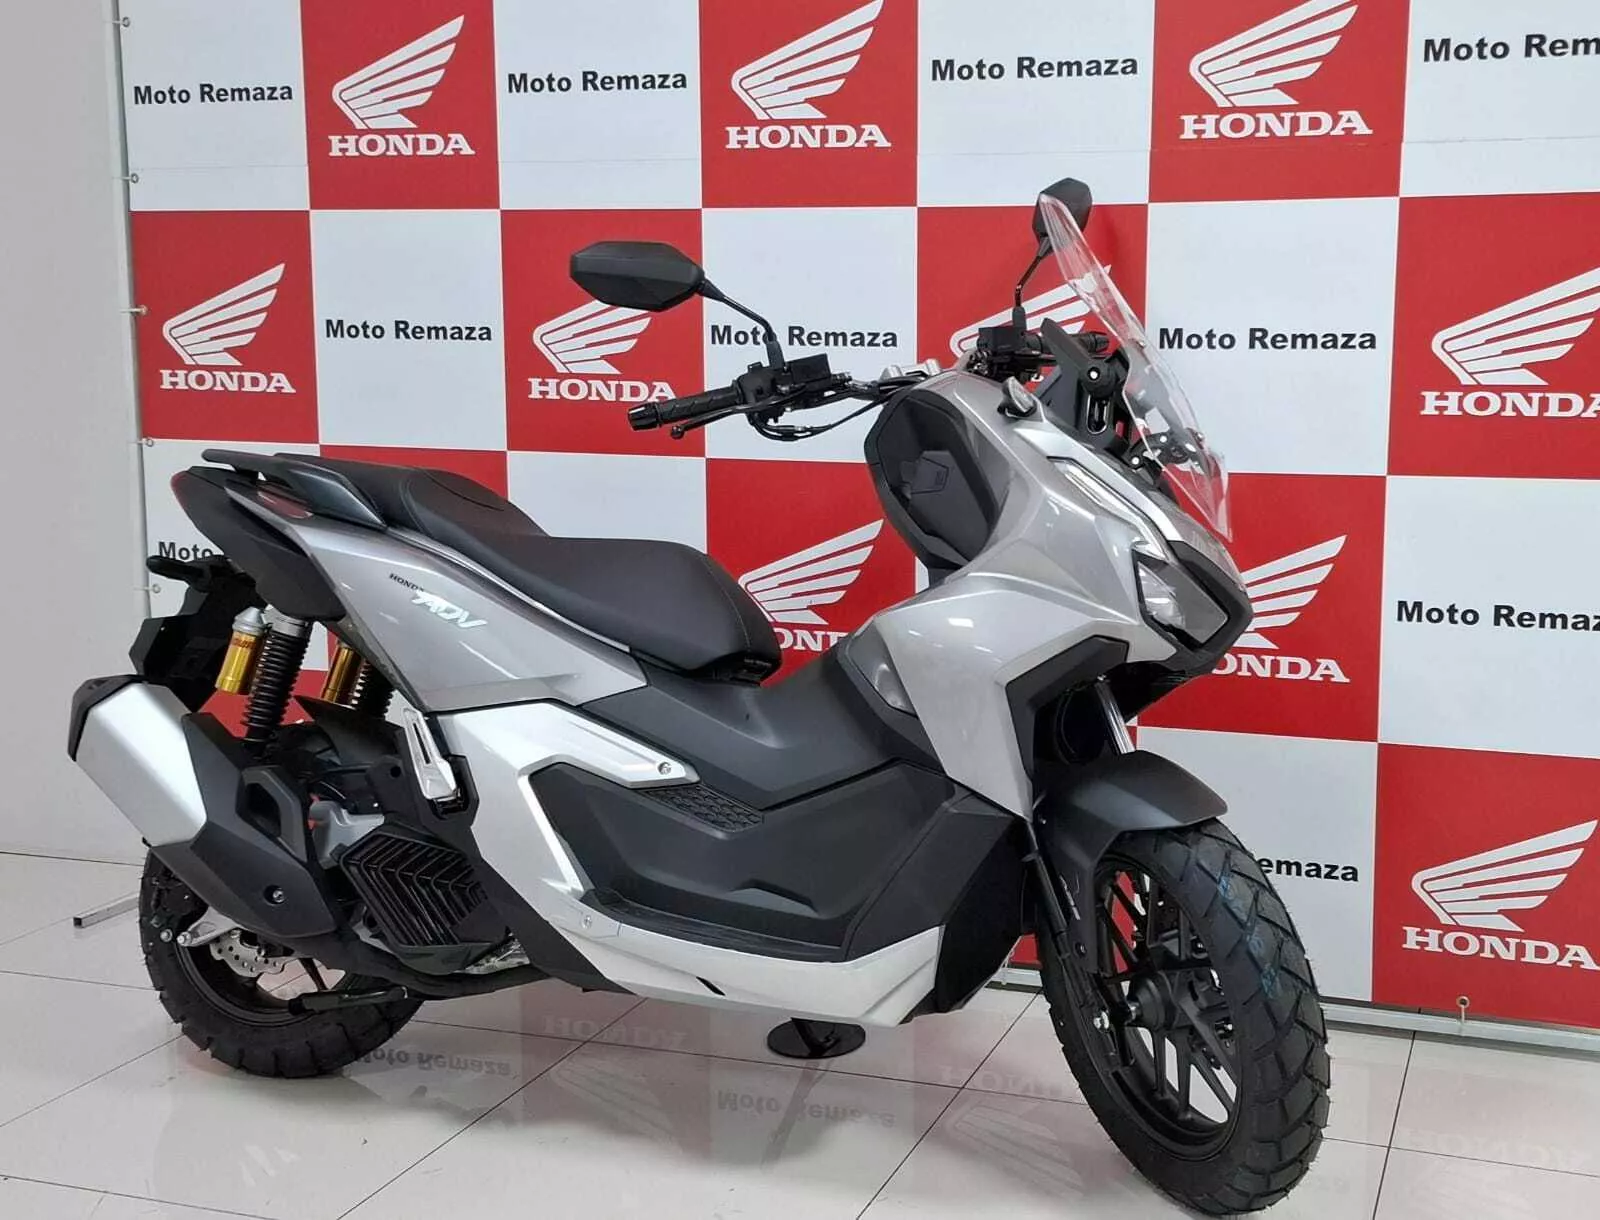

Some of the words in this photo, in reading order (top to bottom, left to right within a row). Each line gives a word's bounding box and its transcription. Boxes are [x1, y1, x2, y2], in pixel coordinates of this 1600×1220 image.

[1423, 37, 1510, 62] Moto
[1524, 33, 1600, 58] Rem
[931, 59, 1005, 81] Moto
[1017, 56, 1138, 79] Remaza
[133, 85, 191, 105] Moto
[199, 83, 293, 103] Remaza
[507, 72, 572, 94] Moto
[582, 70, 687, 92] Remaza
[725, 124, 892, 149] HONDA
[1179, 110, 1374, 140] HONDA
[327, 133, 476, 157] HONDA
[325, 319, 385, 340] Moto
[394, 319, 492, 341] Remaza
[788, 325, 898, 348] Remaza
[1159, 327, 1236, 350] Moto
[1248, 327, 1377, 350] Remaza
[159, 369, 297, 394] HONDA
[527, 377, 677, 403] HONDA
[1397, 600, 1480, 626] Moto
[1212, 653, 1350, 683] ONDA
[1258, 857, 1359, 882] emaza
[1402, 926, 1600, 971] HONDA
